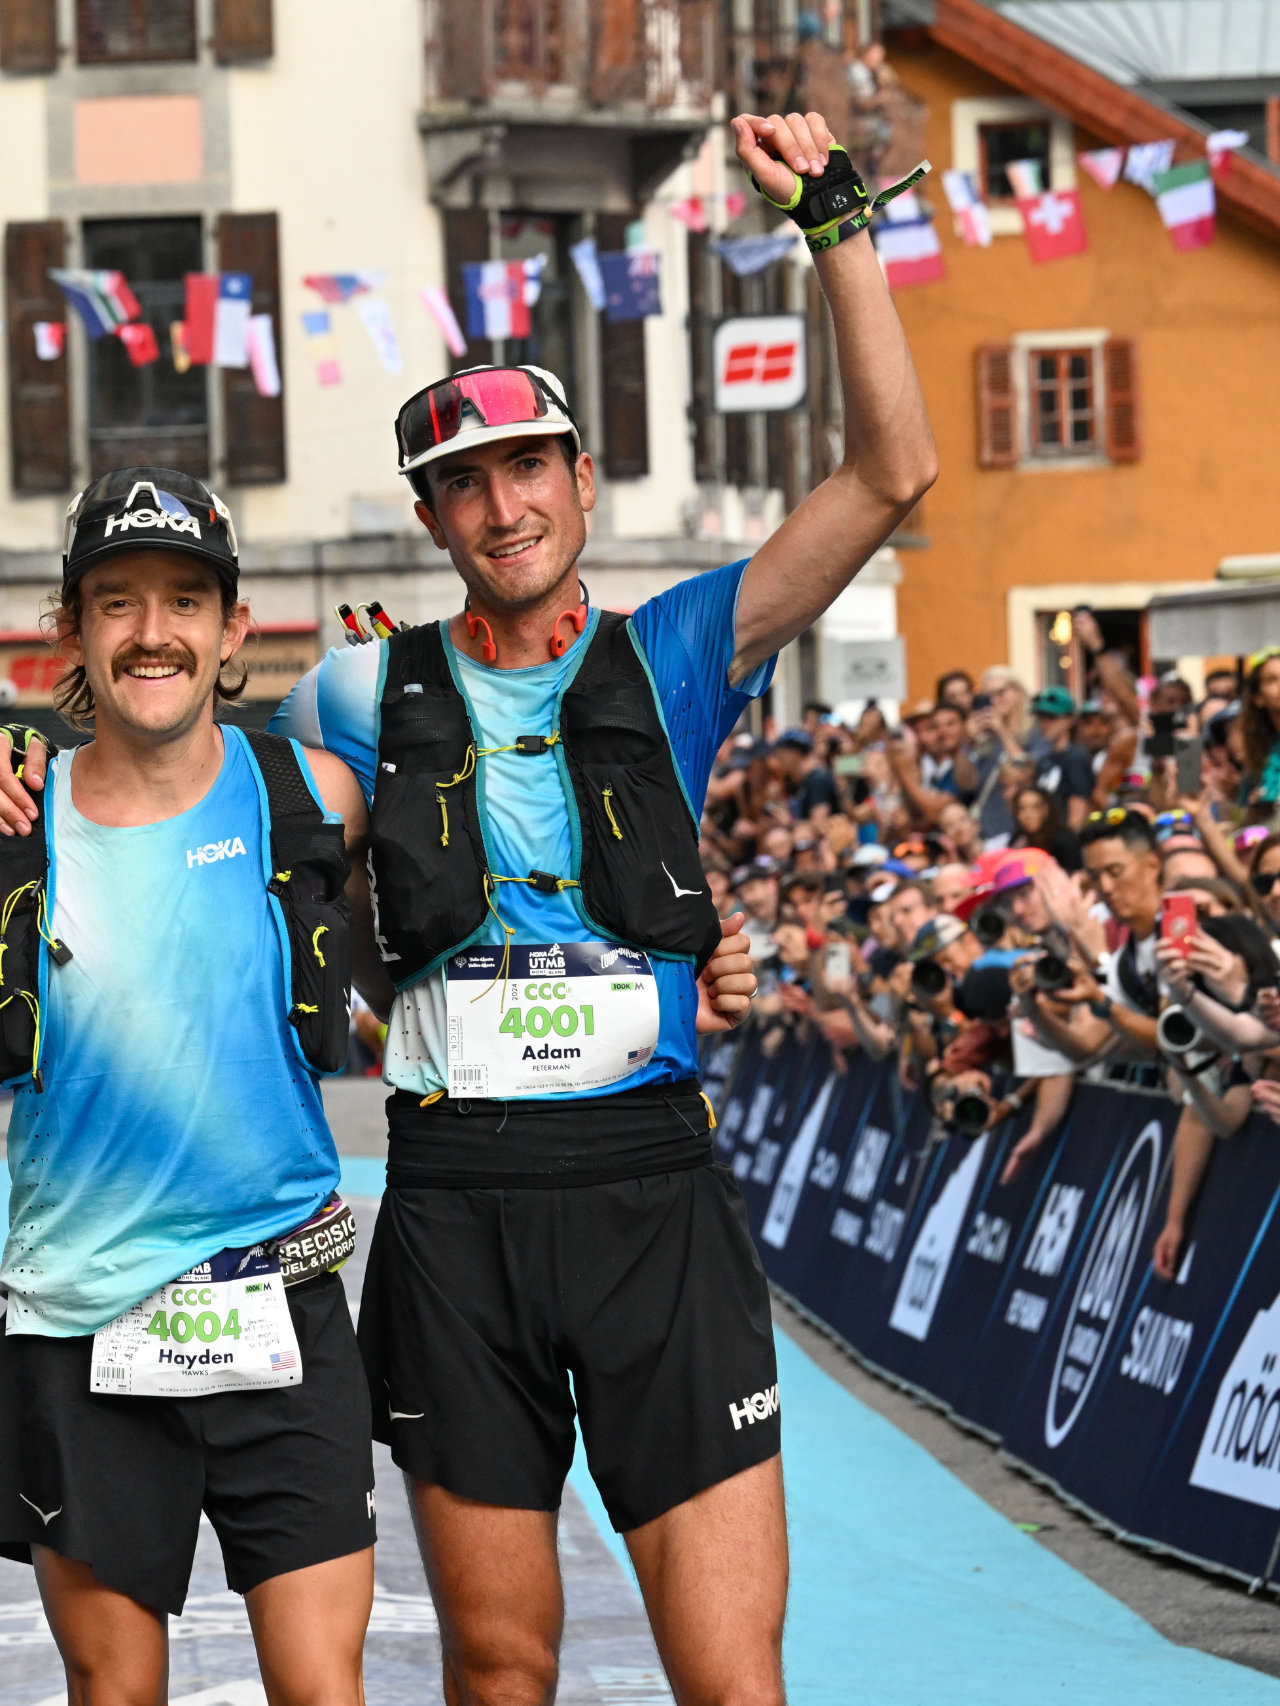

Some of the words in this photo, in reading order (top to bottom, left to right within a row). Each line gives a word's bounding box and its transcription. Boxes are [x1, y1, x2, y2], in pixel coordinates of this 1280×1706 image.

[104, 508, 202, 540] HOKA
[187, 836, 248, 869] HOKA
[529, 957, 565, 969] UTMB
[524, 982, 567, 1001] CCC
[499, 1004, 595, 1039] 4001
[522, 1044, 581, 1060] Adam
[532, 1063, 571, 1072] PETERMAN
[281, 1260, 308, 1276] UEL
[310, 1257, 320, 1268] &
[321, 1235, 356, 1264] HYDRAT
[171, 1288, 212, 1306] CCC
[263, 1283, 272, 1291] M
[148, 1308, 242, 1344] 4004
[158, 1348, 234, 1369] Hayden
[1120, 1305, 1194, 1395] SUUNTO
